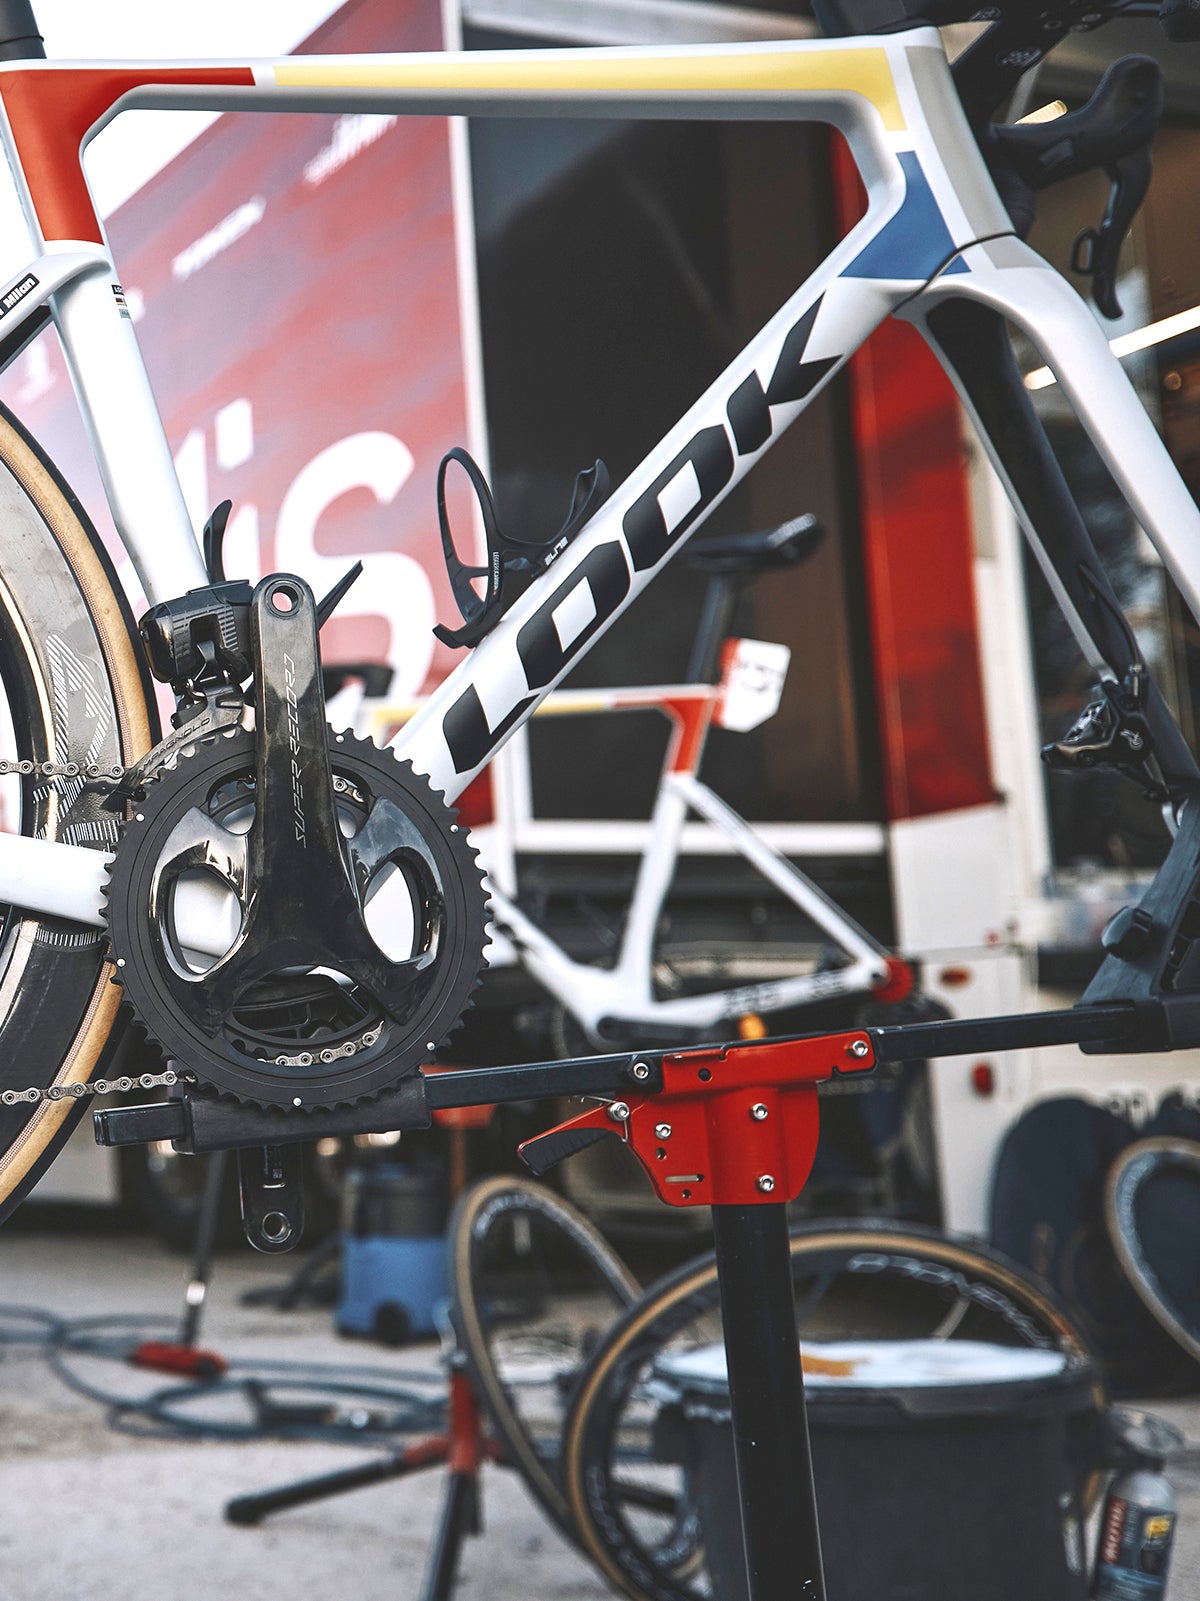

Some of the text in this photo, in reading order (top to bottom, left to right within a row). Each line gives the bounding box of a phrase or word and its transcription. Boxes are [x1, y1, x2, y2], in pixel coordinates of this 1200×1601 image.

[2, 278, 36, 309] Milan
[442, 290, 844, 775] LOOK
[283, 652, 306, 849] SUPER RECORD
